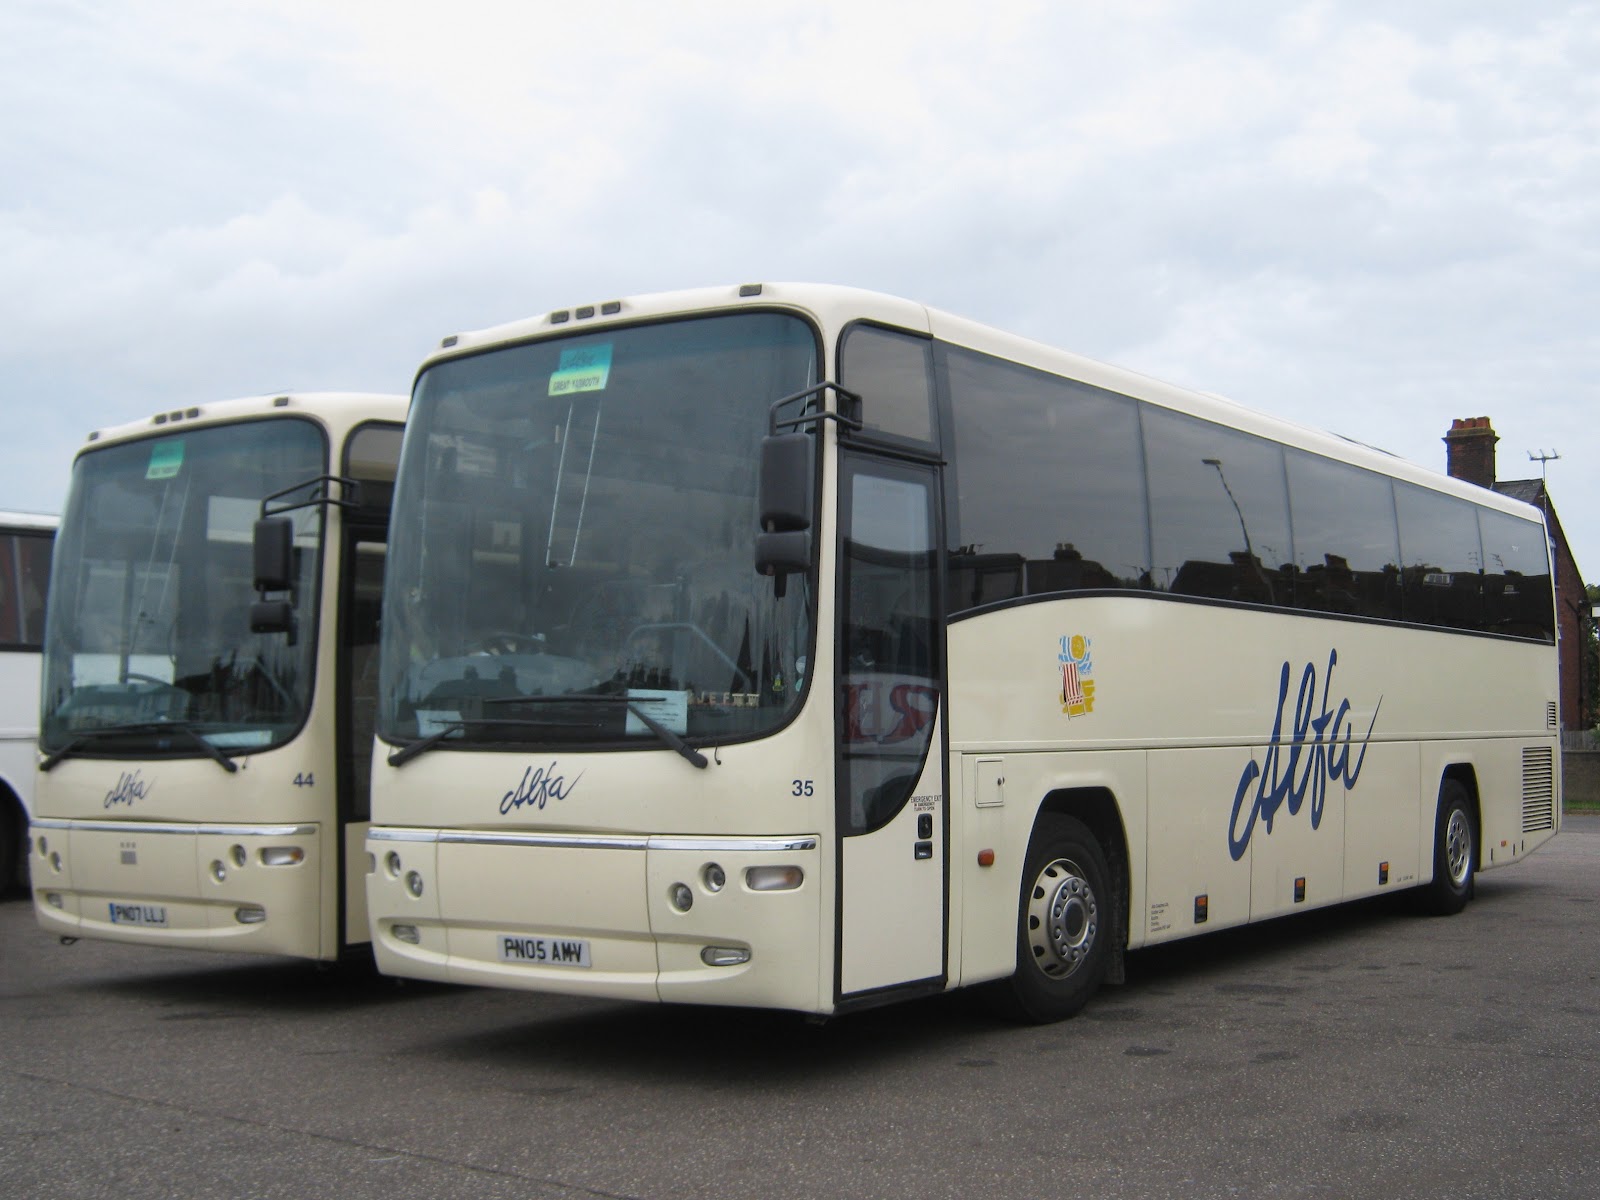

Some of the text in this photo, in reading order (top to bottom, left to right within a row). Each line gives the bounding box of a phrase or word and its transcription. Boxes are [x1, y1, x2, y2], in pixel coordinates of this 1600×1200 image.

[1228, 648, 1376, 862] Alfa
[104, 768, 159, 809] Alfa
[292, 772, 316, 788] 44
[500, 761, 586, 815] Alfa
[792, 779, 814, 797] 35
[910, 794, 942, 803] EMERGENCY EXIT
[115, 905, 165, 923] PN07 LLJ
[504, 938, 582, 963] PN05 AMV
